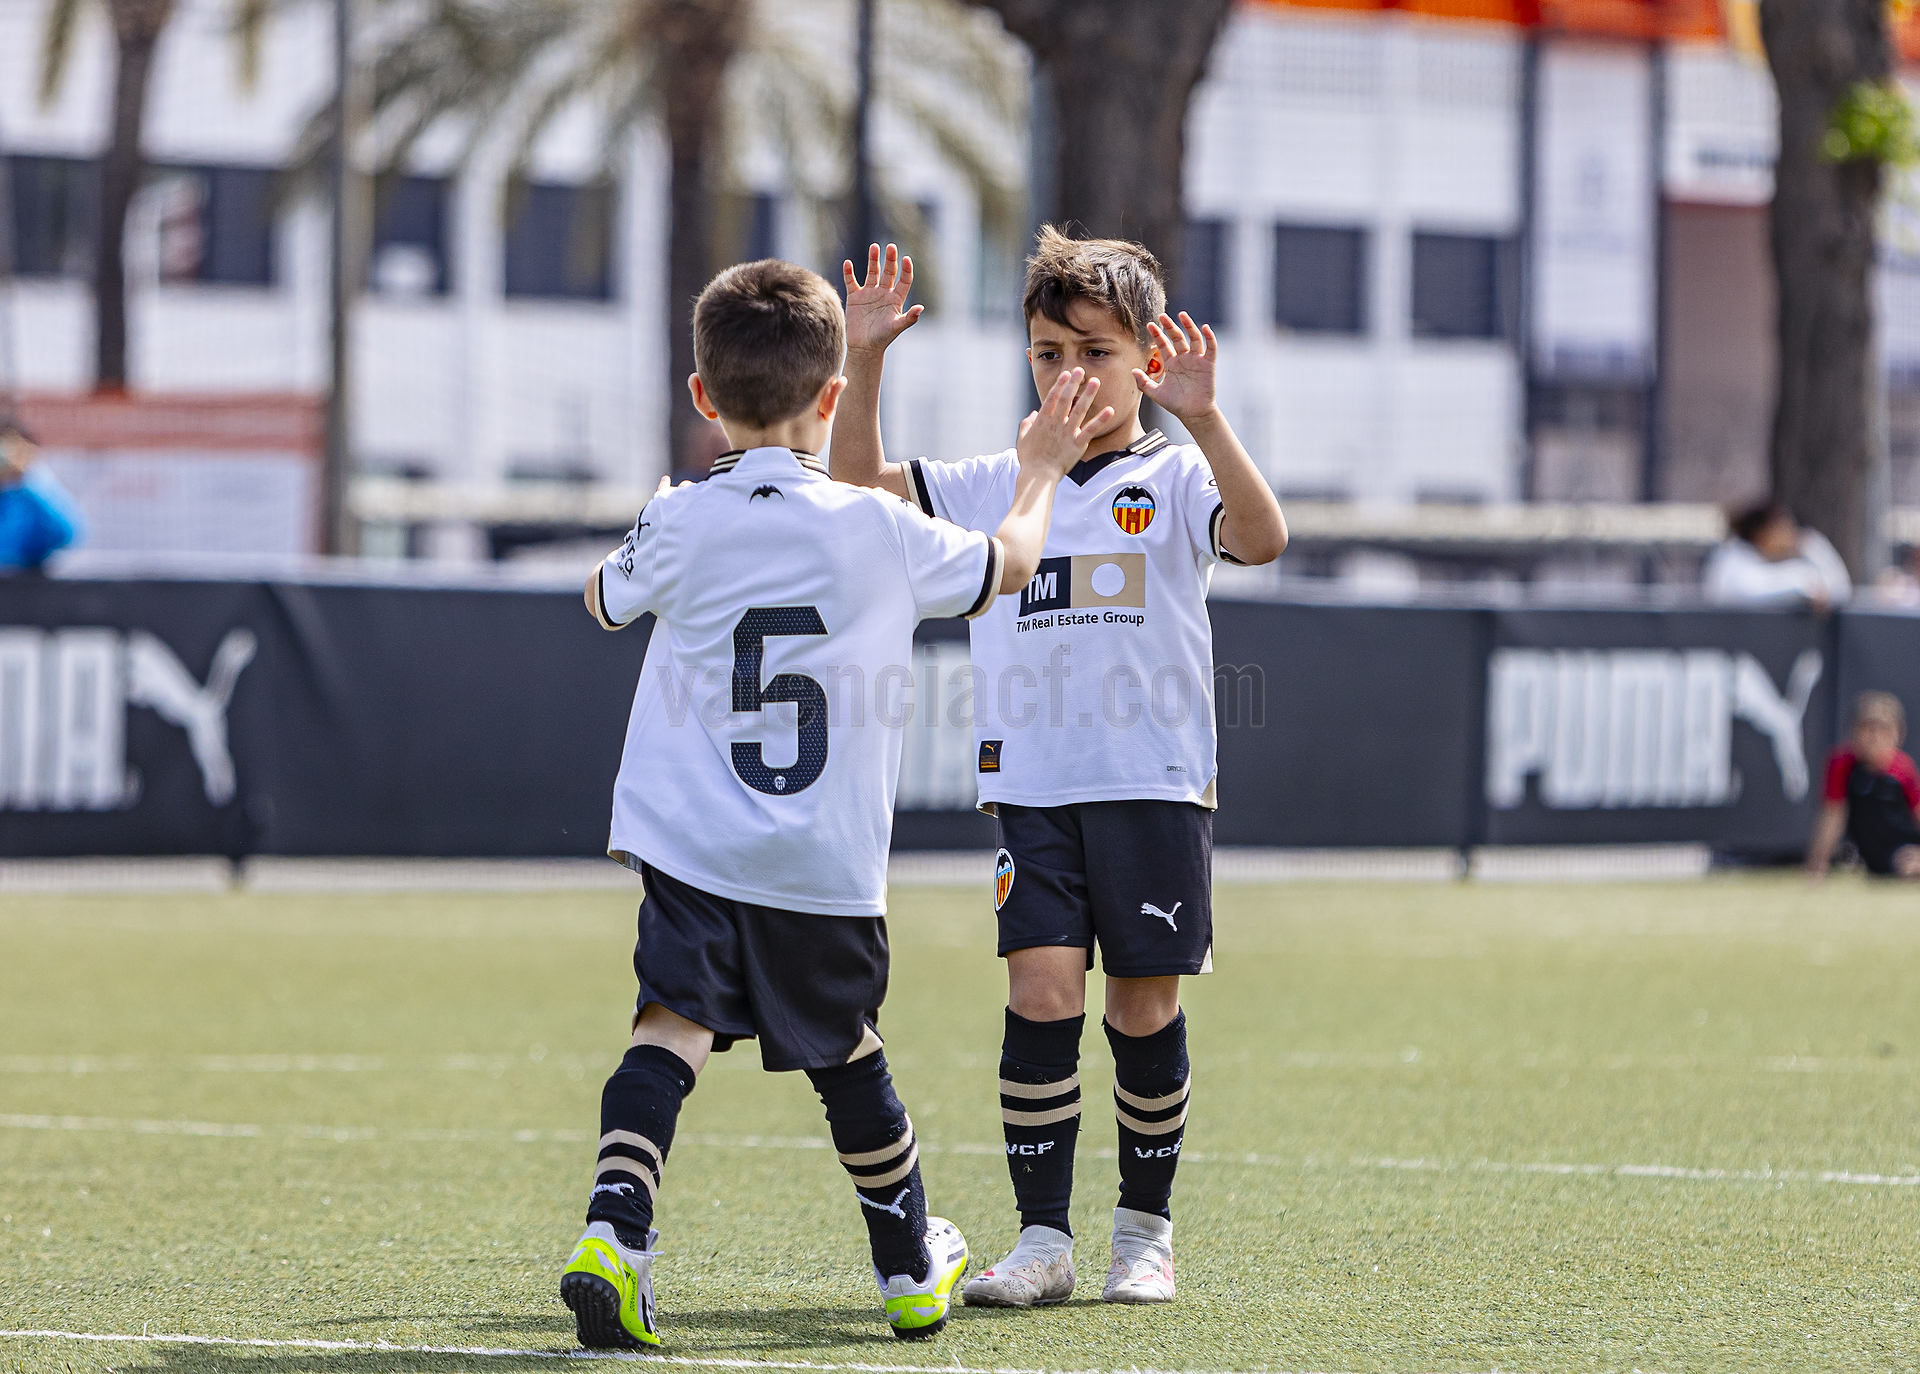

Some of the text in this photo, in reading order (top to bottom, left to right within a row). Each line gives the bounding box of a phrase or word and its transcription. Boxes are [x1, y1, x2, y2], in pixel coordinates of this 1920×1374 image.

[1027, 571, 1057, 604] TM
[1016, 611, 1145, 633] TM Real Estate Group
[730, 605, 829, 796] 5
[1486, 648, 1734, 809] PUMA
[1005, 1140, 1055, 1156] VCF
